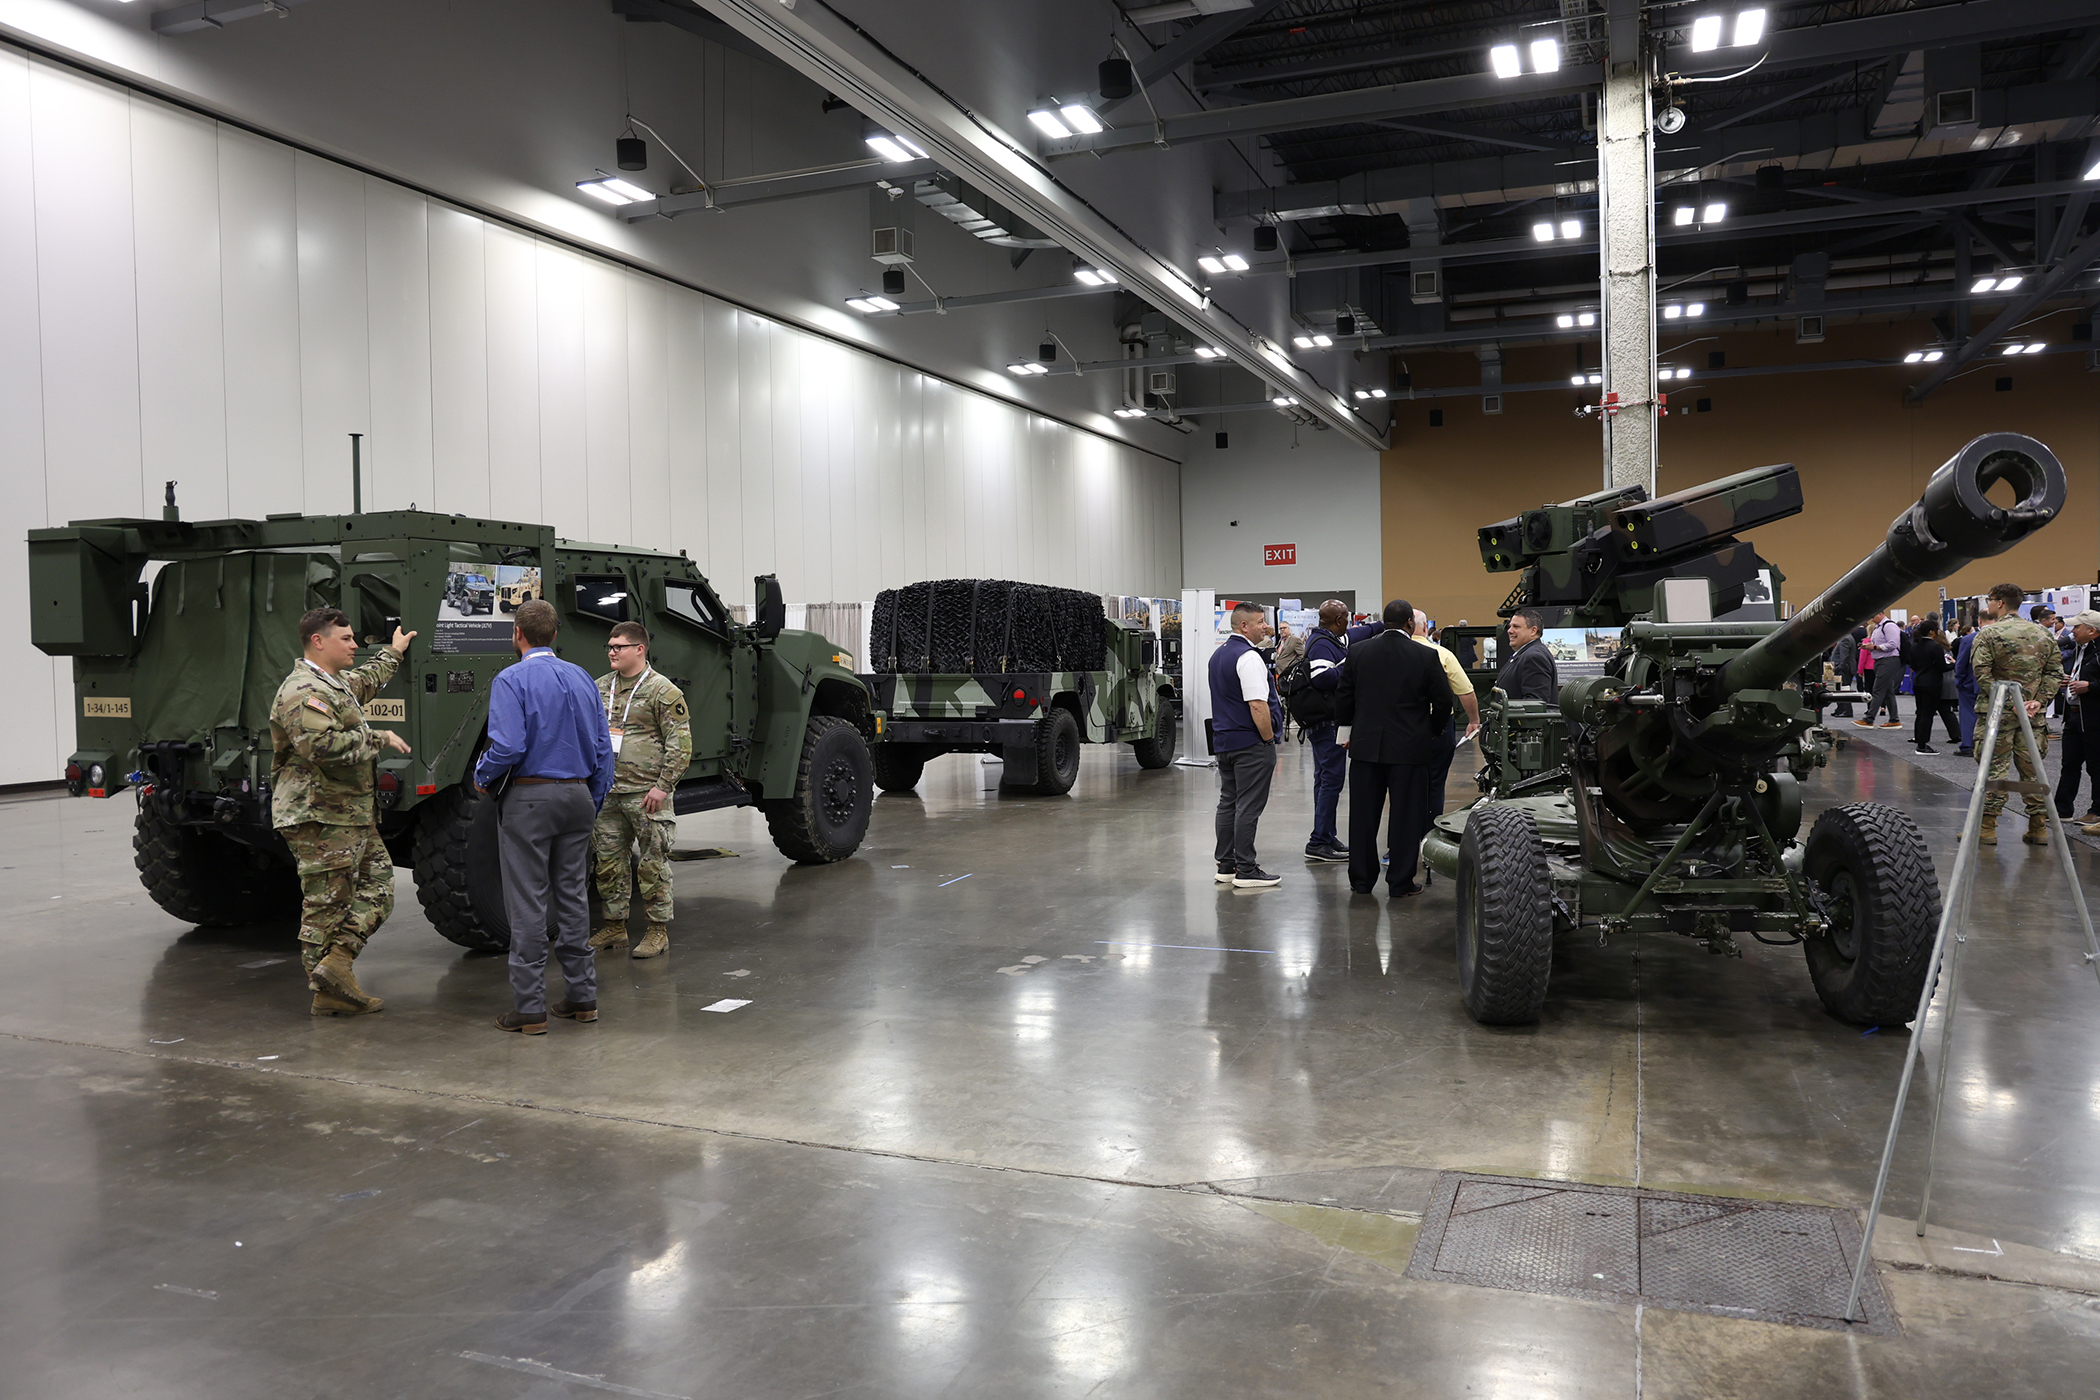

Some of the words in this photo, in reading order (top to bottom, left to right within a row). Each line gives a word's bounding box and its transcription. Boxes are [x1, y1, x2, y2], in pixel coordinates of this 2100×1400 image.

[1265, 549, 1295, 561] EXIT
[1730, 626, 1755, 636] ONLY
[87, 703, 129, 714] 1-34/1-145
[361, 704, 404, 717] -102-01
